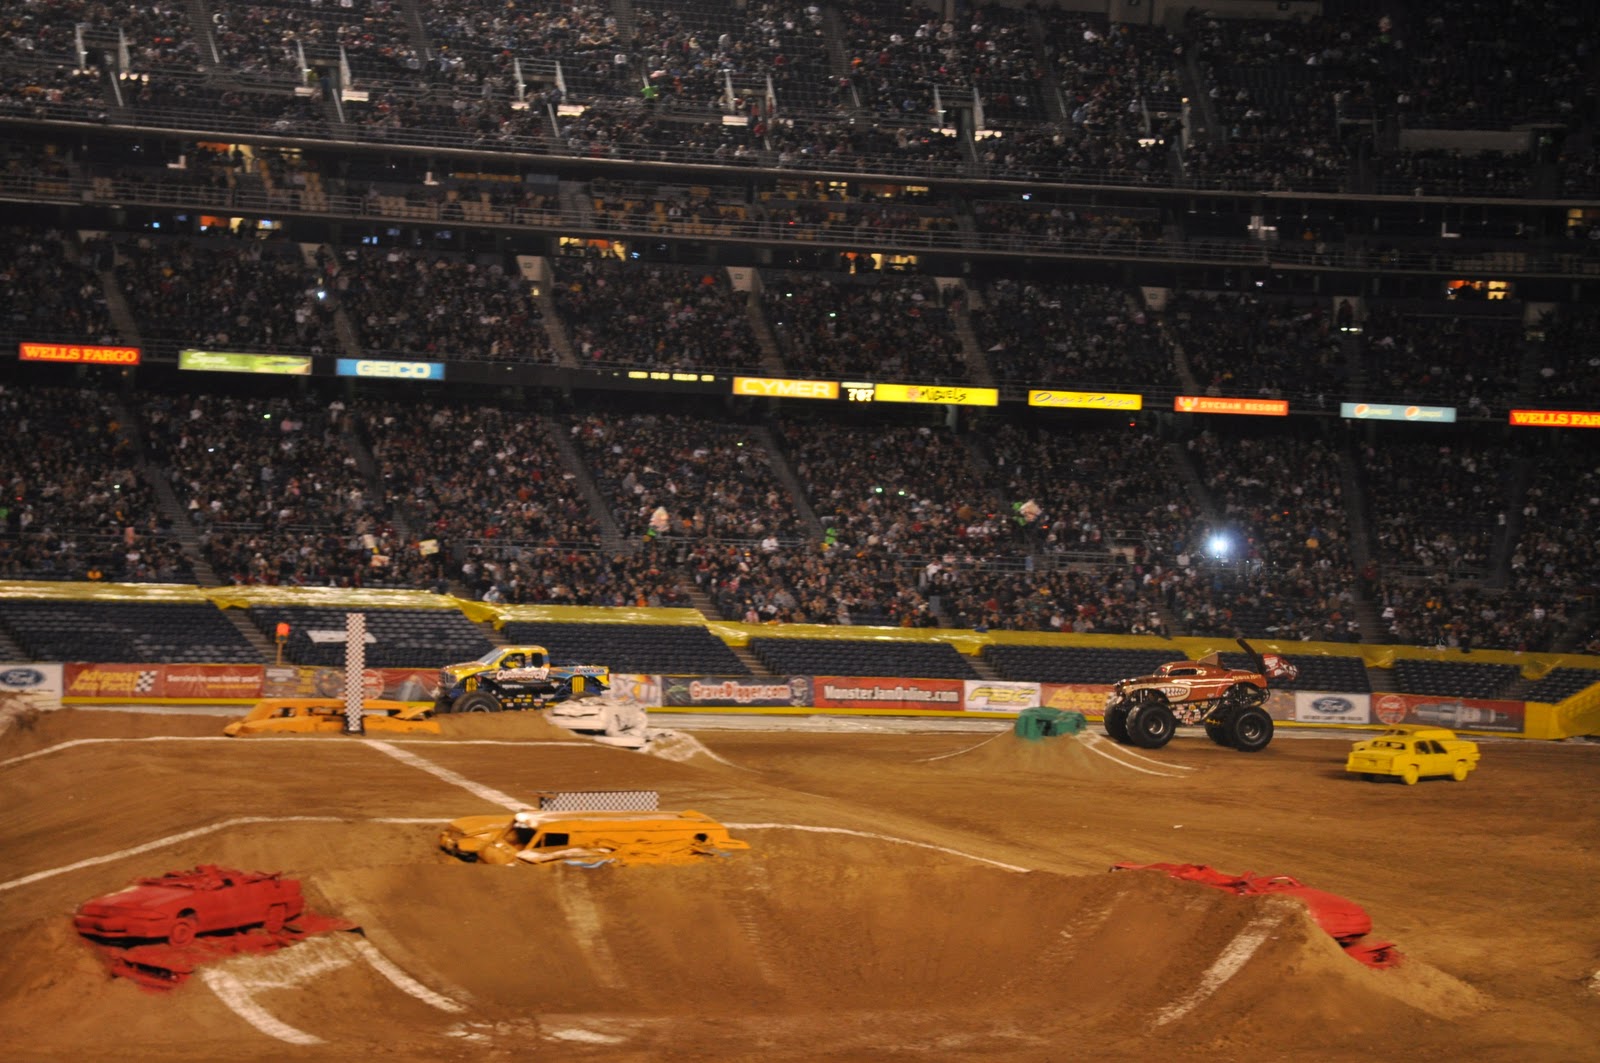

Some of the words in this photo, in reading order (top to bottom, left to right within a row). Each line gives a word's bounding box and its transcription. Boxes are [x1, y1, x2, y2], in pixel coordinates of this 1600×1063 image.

[24, 346, 80, 360] WELLS
[83, 349, 137, 362] FARGO
[356, 360, 431, 378] GEICO
[741, 379, 830, 396] CYMER
[1512, 412, 1569, 424] WELLS
[690, 681, 791, 703] GraveDigger.com
[823, 685, 959, 702] MonsterJamOnline.com
